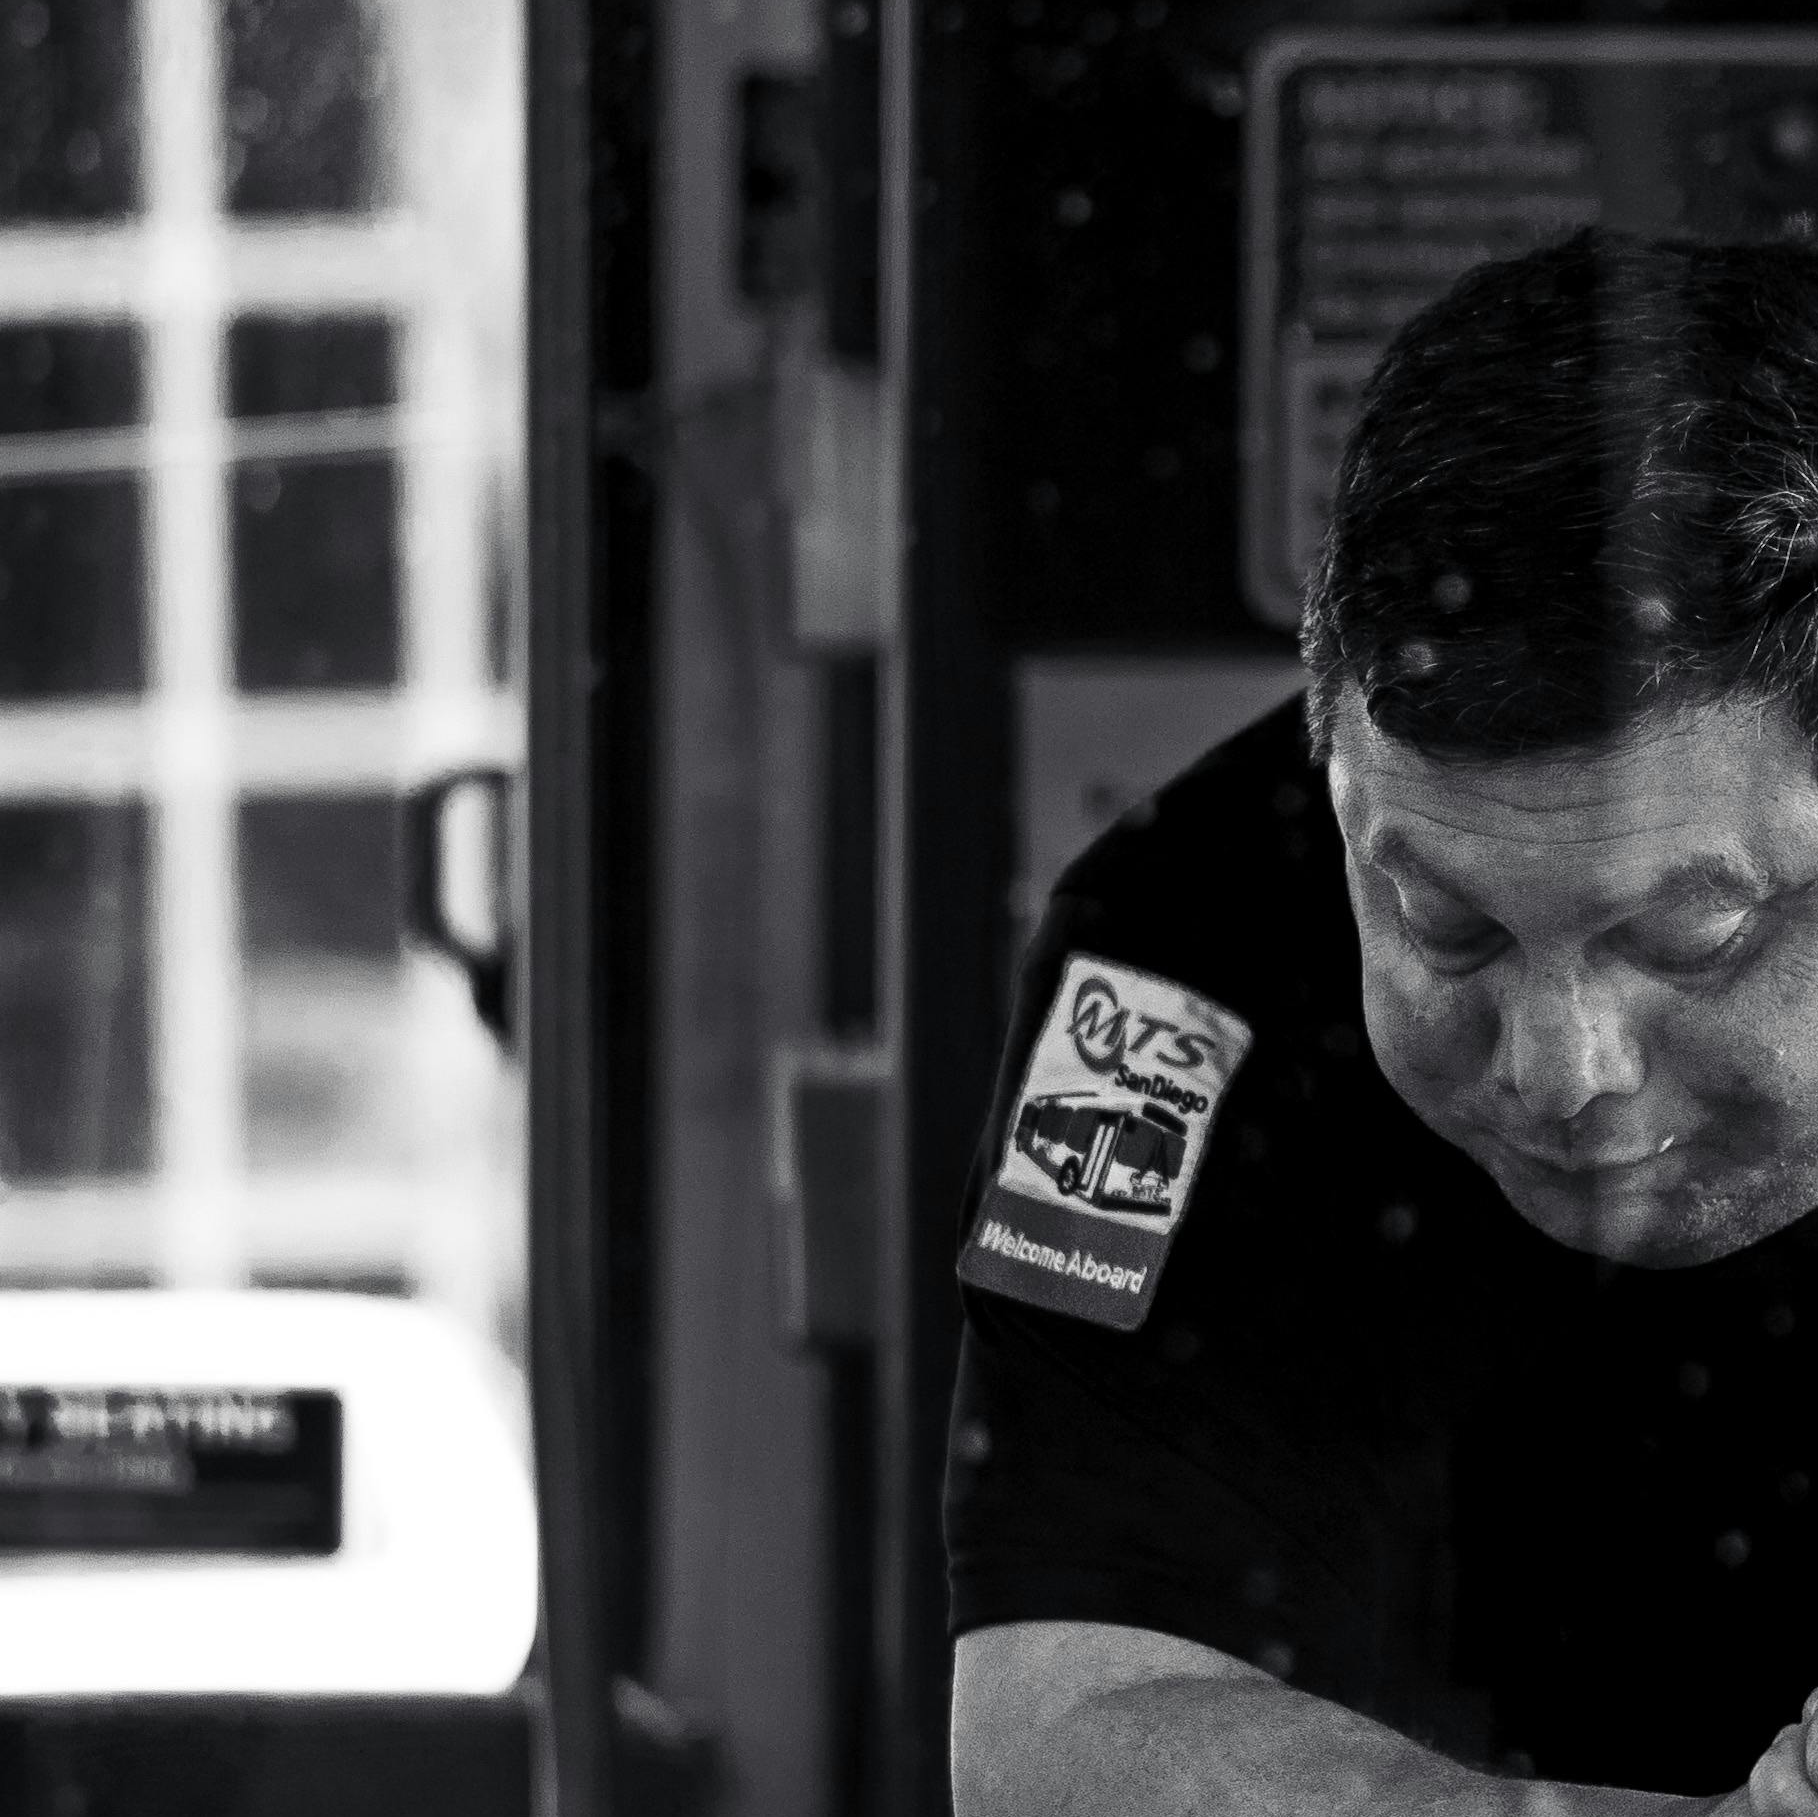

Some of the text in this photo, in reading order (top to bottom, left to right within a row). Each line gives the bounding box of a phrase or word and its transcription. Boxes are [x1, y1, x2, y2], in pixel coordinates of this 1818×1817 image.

[1066, 1000, 1217, 1069] MTS
[977, 1218, 1148, 1295] Welcome Aboard
